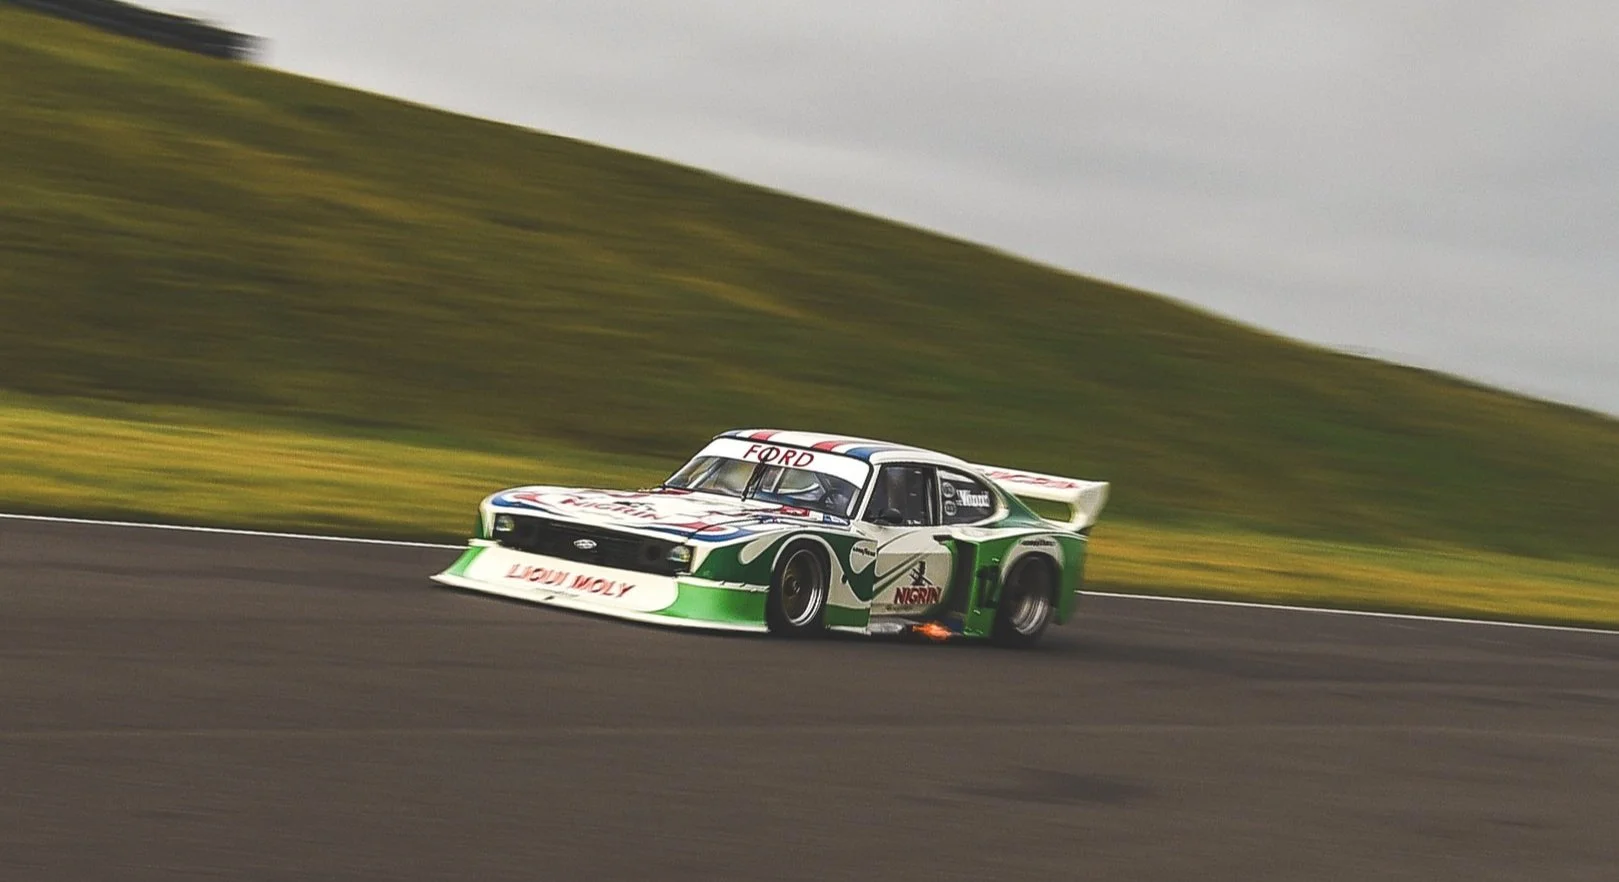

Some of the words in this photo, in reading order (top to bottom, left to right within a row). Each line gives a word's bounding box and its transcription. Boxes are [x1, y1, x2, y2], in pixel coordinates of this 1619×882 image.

[743, 444, 814, 467] FORD
[567, 575, 636, 598] MOLY
[894, 586, 942, 605] NIGRIN
